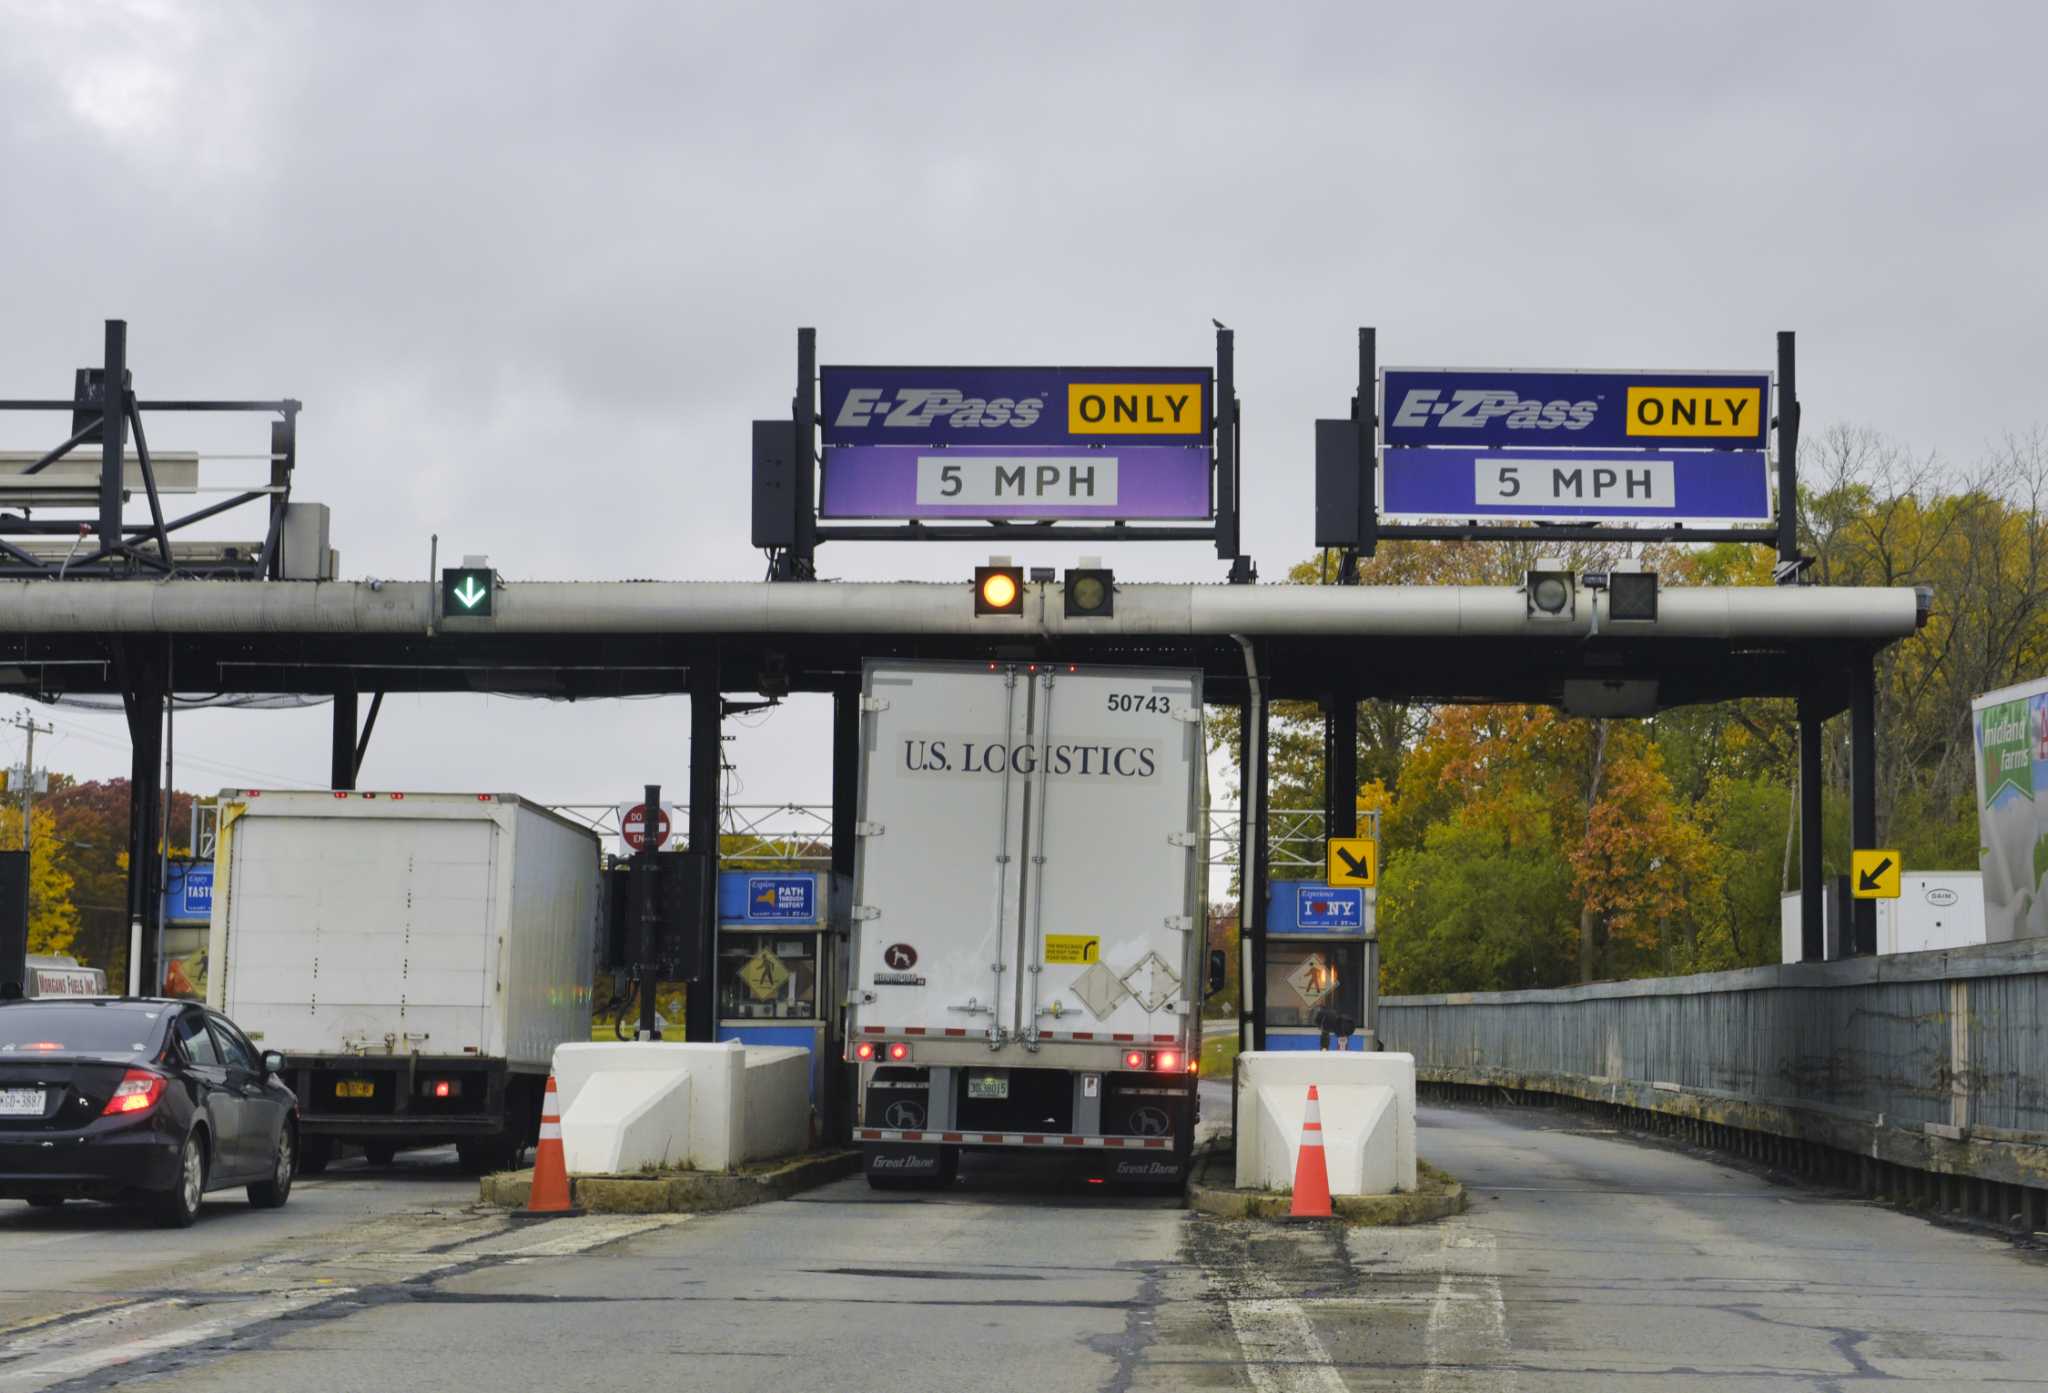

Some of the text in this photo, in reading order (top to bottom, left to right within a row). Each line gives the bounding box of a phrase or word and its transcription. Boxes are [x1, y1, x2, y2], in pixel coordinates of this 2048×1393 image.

[834, 388, 1189, 428] E-ZPass ONLY
[1392, 389, 1748, 430] E-ZPass ONLY
[941, 466, 1095, 497] 5 MPH
[1499, 468, 1652, 499] 5 MPH
[1108, 693, 1171, 714] 50743
[1984, 720, 2025, 748] midland
[905, 740, 1155, 777] U.S. LOGISTICS
[2001, 748, 2029, 772] farms
[631, 812, 643, 822] DO
[778, 887, 804, 897] PATH
[1304, 901, 1354, 916] I NY
[39, 975, 65, 994] MORGANS
[67, 975, 83, 995] FUELS
[872, 1155, 934, 1169] Great Dane
[1117, 1162, 1178, 1174] Great Dane
